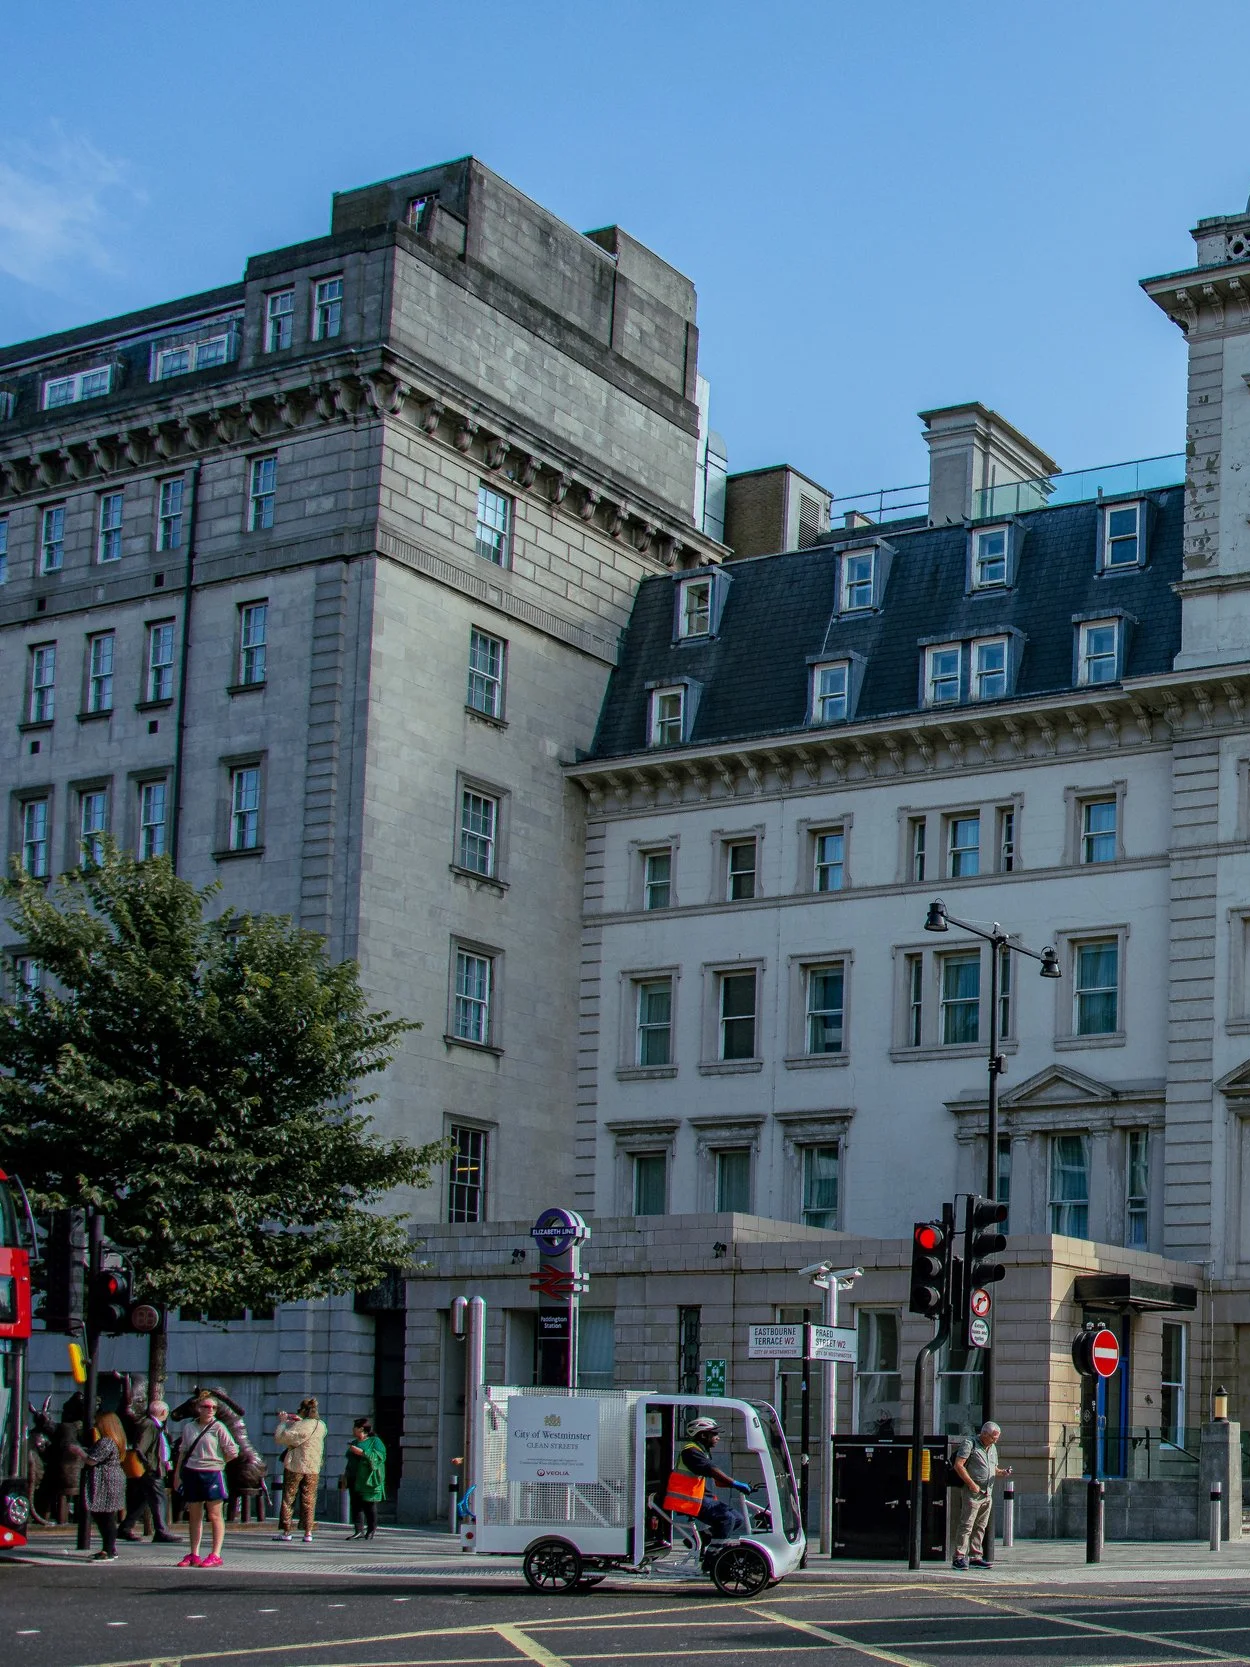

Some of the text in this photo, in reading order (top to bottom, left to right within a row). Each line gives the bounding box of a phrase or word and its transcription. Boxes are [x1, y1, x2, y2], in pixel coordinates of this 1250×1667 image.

[532, 1227, 574, 1236] ELIZABETH LINE
[540, 1316, 567, 1324] Paddington
[754, 1327, 796, 1336] EASTBOURNE
[815, 1328, 834, 1338] PRAED
[754, 1337, 795, 1345] TERRACE W2
[815, 1338, 846, 1349] STREET W2
[514, 1430, 591, 1440] City of Westminster
